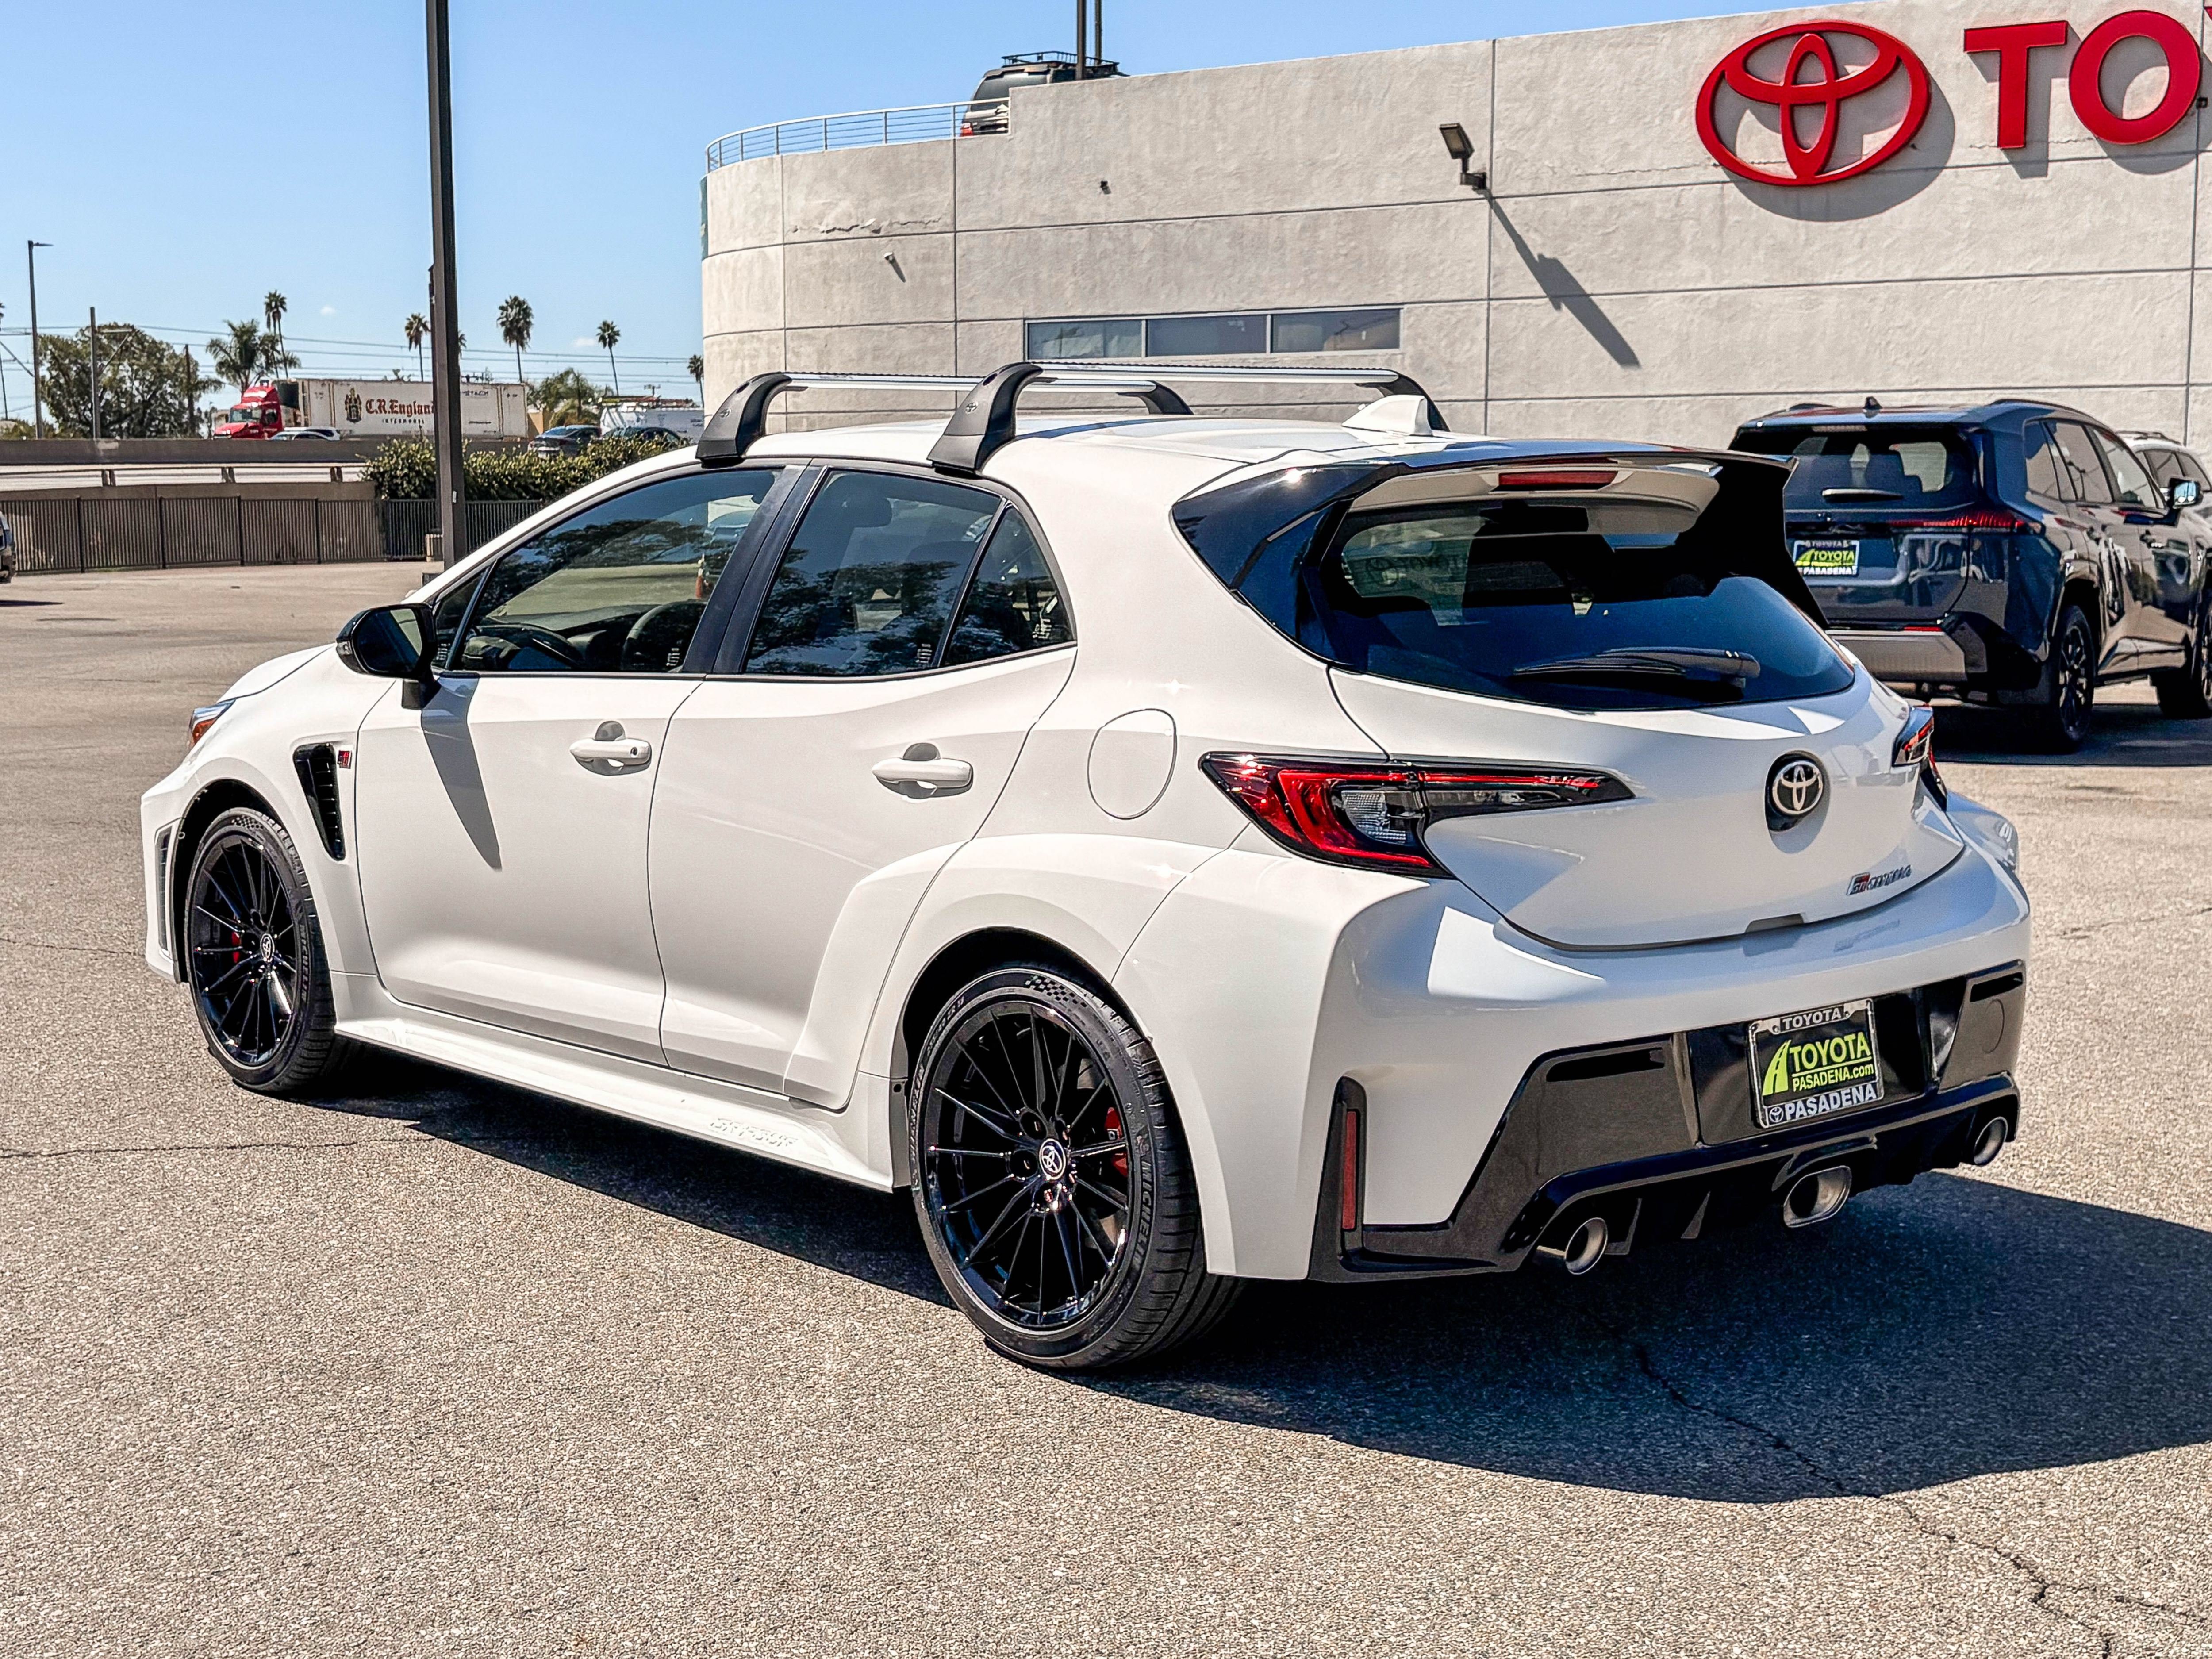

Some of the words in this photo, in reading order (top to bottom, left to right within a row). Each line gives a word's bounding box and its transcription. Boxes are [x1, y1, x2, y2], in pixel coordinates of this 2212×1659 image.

[1963, 6, 2212, 149] TO
[1814, 550, 1855, 561] TOYOTA
[1782, 1008, 1842, 1030] TOYOTA
[1789, 1032, 1872, 1072] TOYOTA
[1792, 1064, 1874, 1092] PASADENA.com
[1785, 1084, 1878, 1121] PASADENA
[1133, 1160, 1153, 1270] MICHELIN
